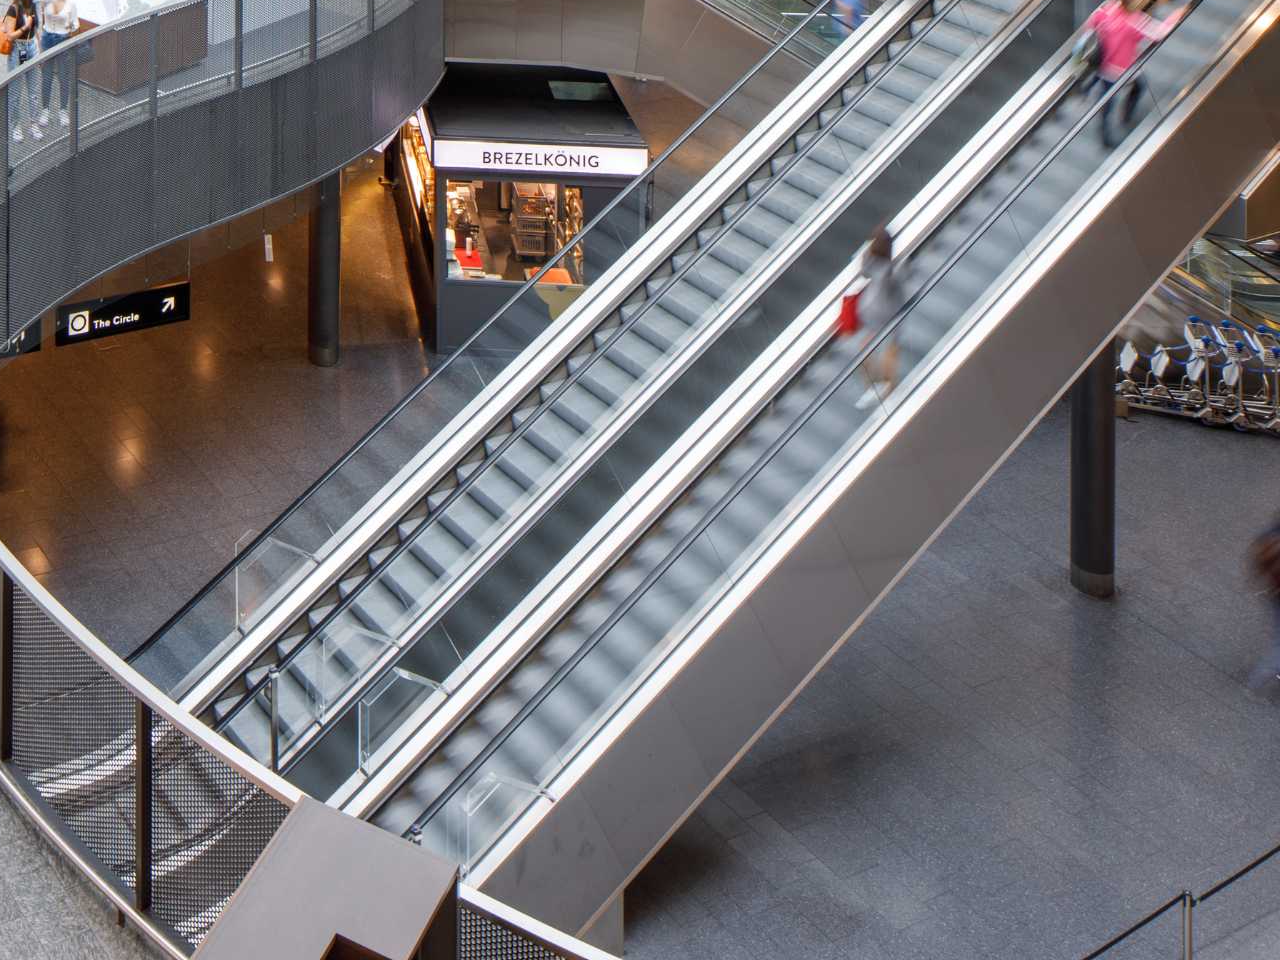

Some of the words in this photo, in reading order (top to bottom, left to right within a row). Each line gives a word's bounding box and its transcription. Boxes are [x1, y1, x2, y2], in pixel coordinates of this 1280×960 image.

[482, 150, 600, 168] BREZELKÖNIG
[93, 319, 111, 329] The
[113, 313, 140, 325] Circle
